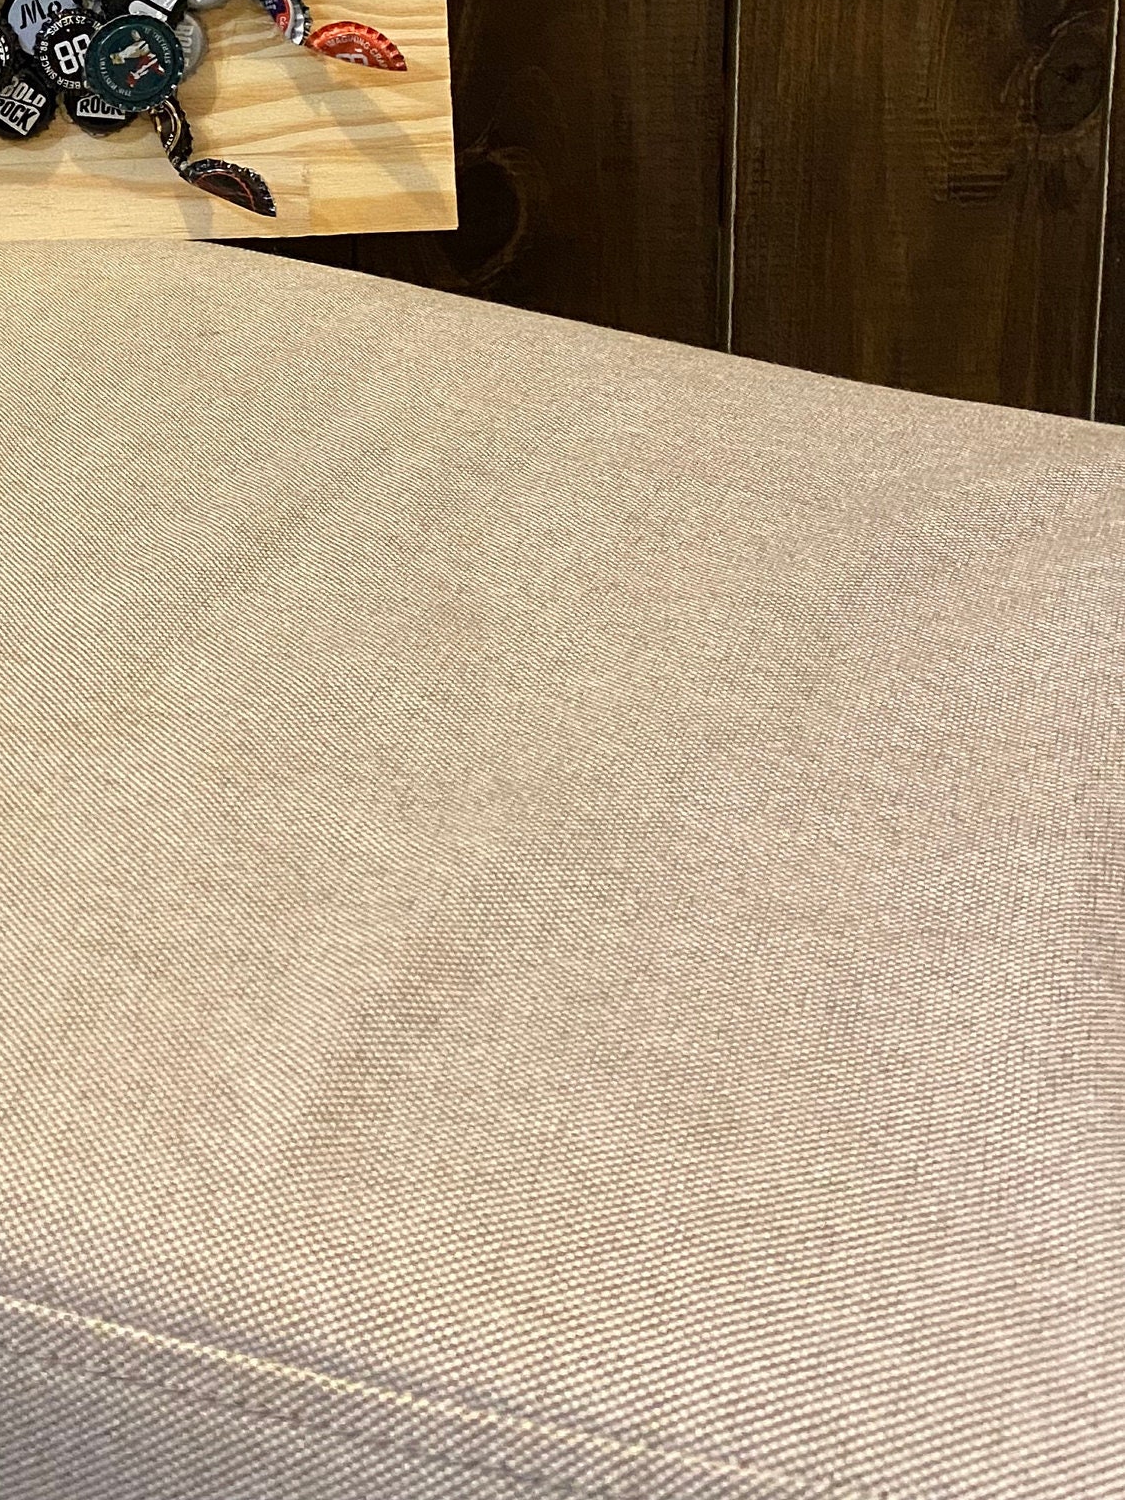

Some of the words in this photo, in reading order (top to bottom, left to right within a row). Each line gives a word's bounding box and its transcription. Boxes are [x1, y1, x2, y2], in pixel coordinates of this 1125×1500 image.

[45, 18, 74, 36] YEARS
[54, 33, 91, 76] 88
[40, 54, 60, 81] SINCE
[56, 77, 81, 90] BEER
